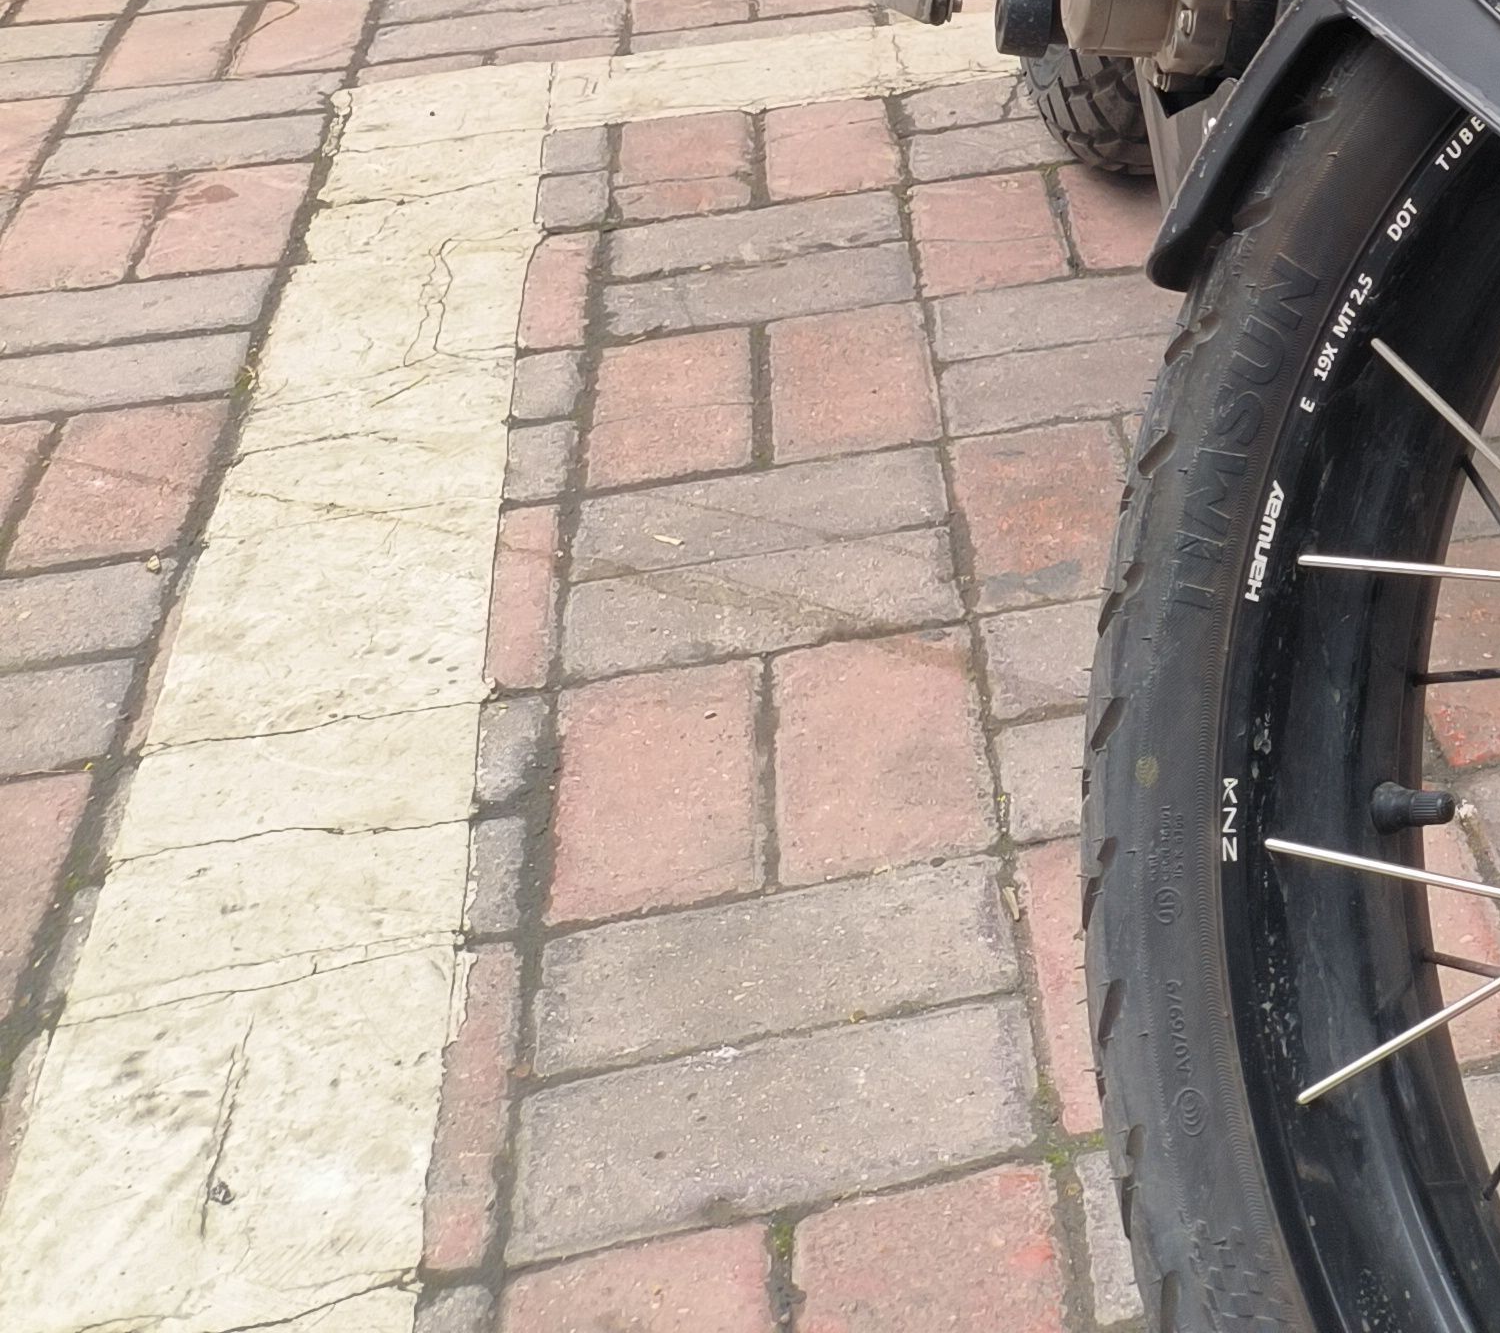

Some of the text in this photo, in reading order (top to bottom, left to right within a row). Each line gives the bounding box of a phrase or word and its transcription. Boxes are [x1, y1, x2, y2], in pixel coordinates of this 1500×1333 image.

[1300, 396, 1316, 413] E
[1313, 342, 1339, 382] 19X
[1332, 302, 1357, 339] MT
[1386, 197, 1418, 242] DOT
